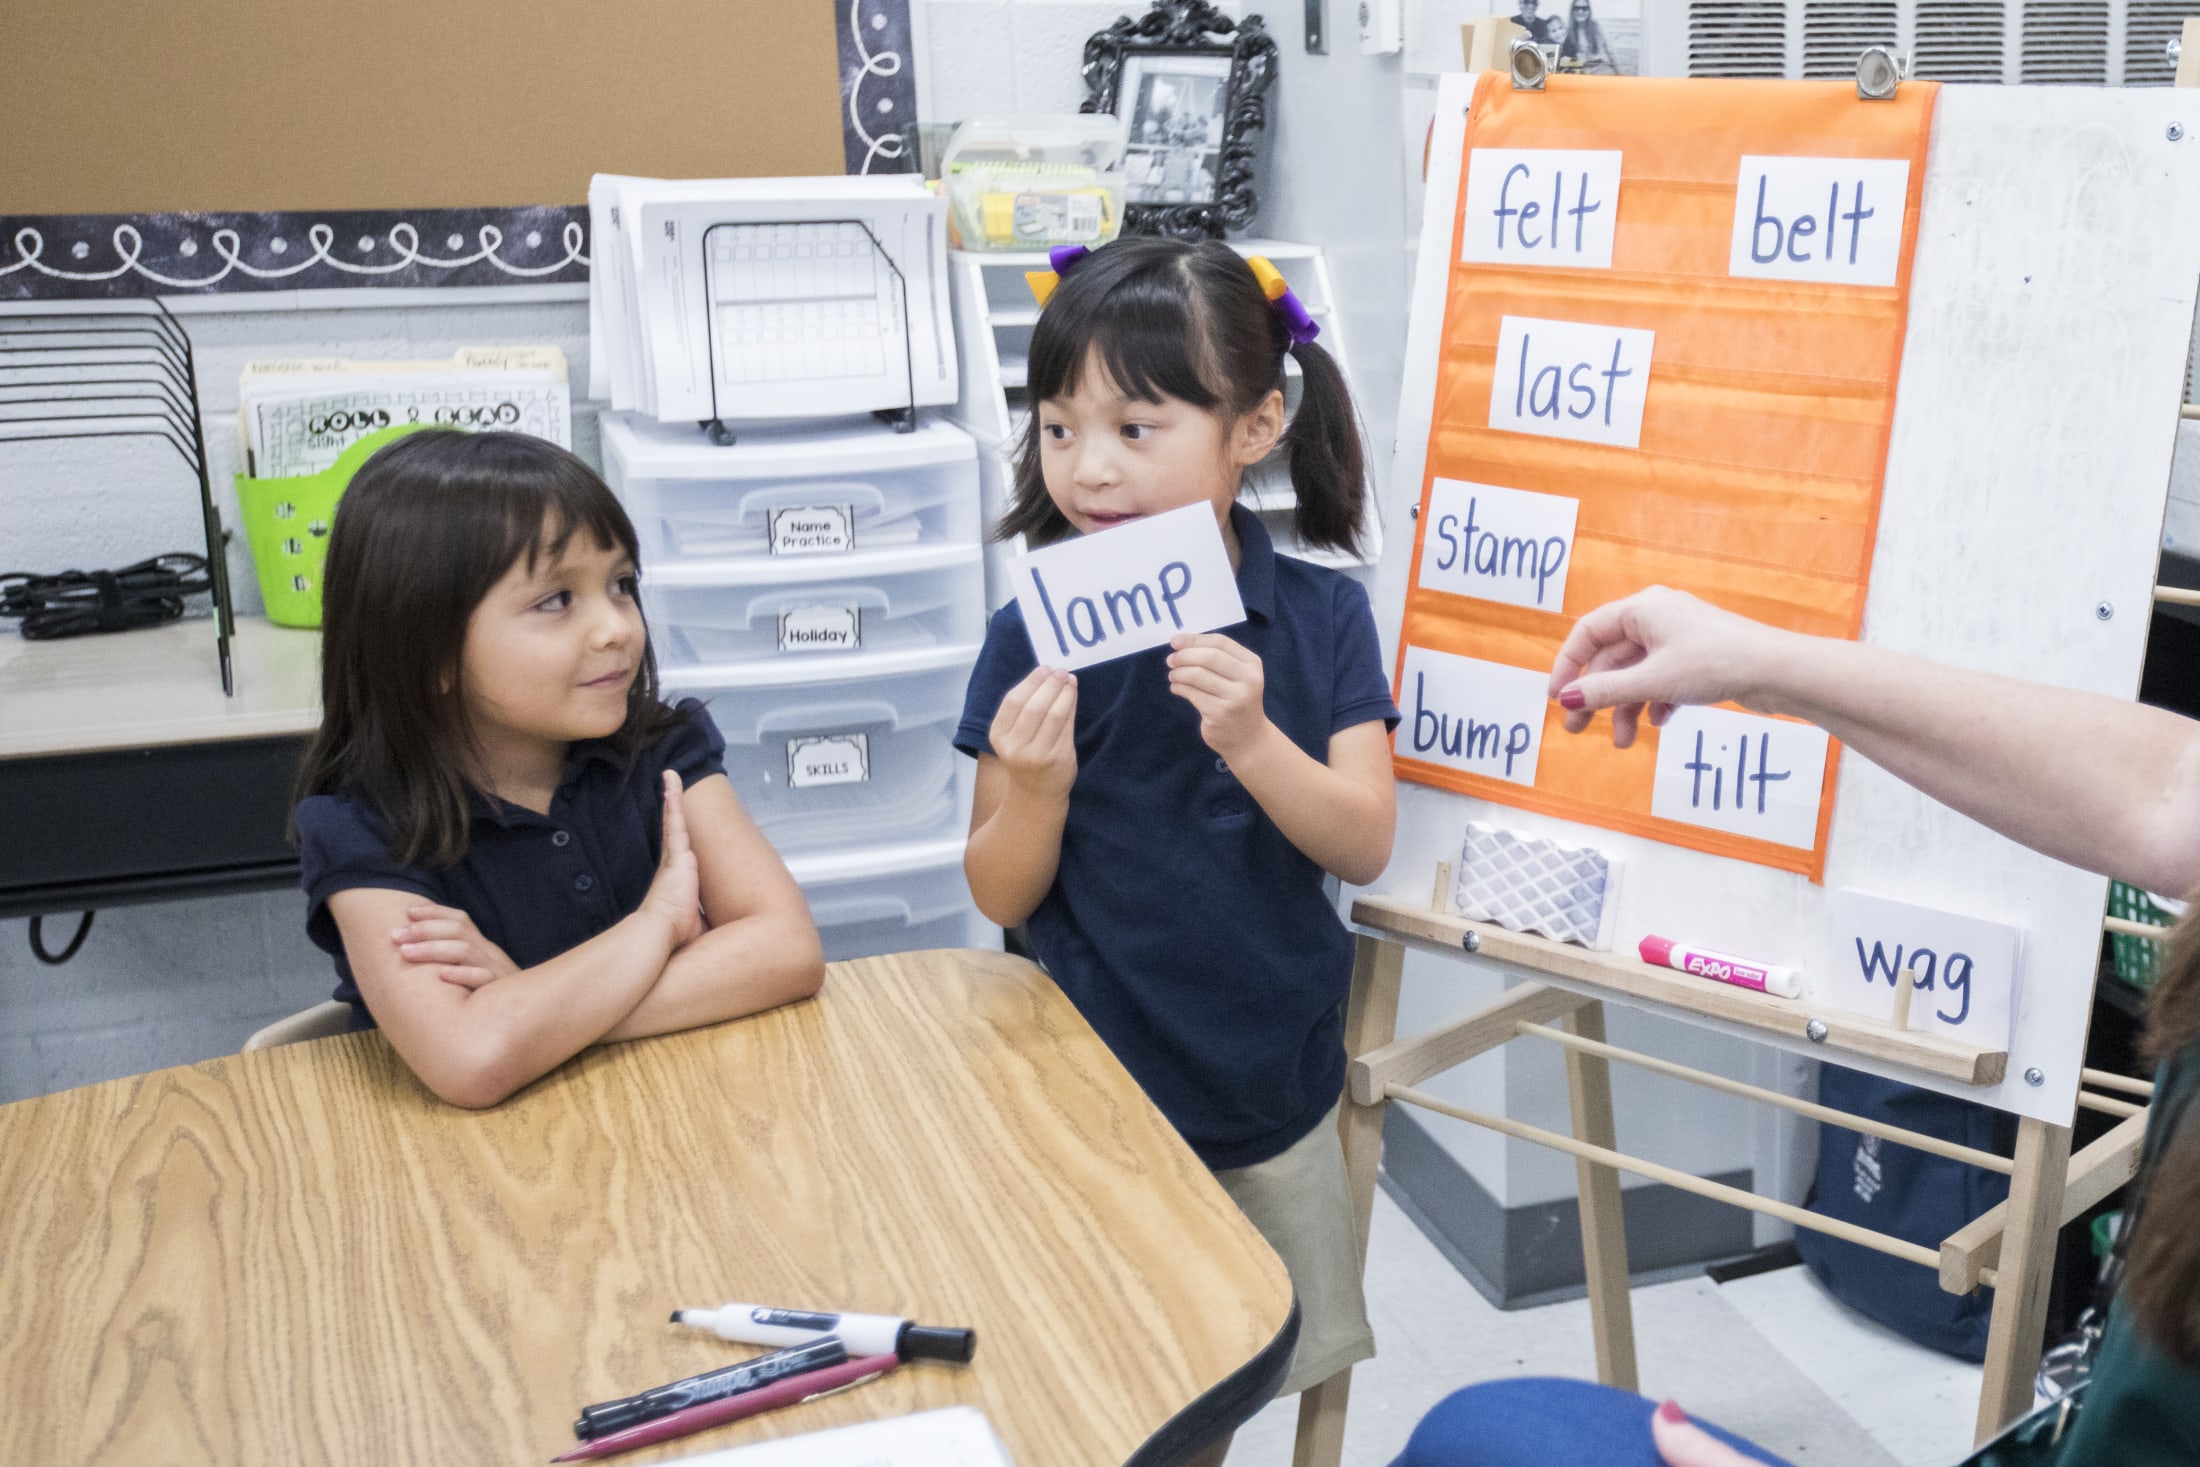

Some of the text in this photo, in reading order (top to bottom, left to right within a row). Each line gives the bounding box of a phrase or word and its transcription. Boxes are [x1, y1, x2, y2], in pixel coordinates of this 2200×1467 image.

[1493, 163, 1601, 252] felt
[1750, 174, 1876, 265] belt
[308, 409, 391, 435] ROLL
[434, 402, 521, 426] READ
[1515, 333, 1633, 426] last
[782, 534, 842, 548] Practice
[789, 520, 831, 533] Name
[1435, 496, 1567, 604] stamp
[789, 627, 848, 645] Holiday
[1030, 561, 1192, 657] lamp
[1412, 671, 1531, 776] bump
[806, 762, 849, 778] SKILLS
[1685, 730, 1792, 814] tilt
[1688, 958, 1731, 979] EXPO
[1855, 936, 1975, 1025] wag
